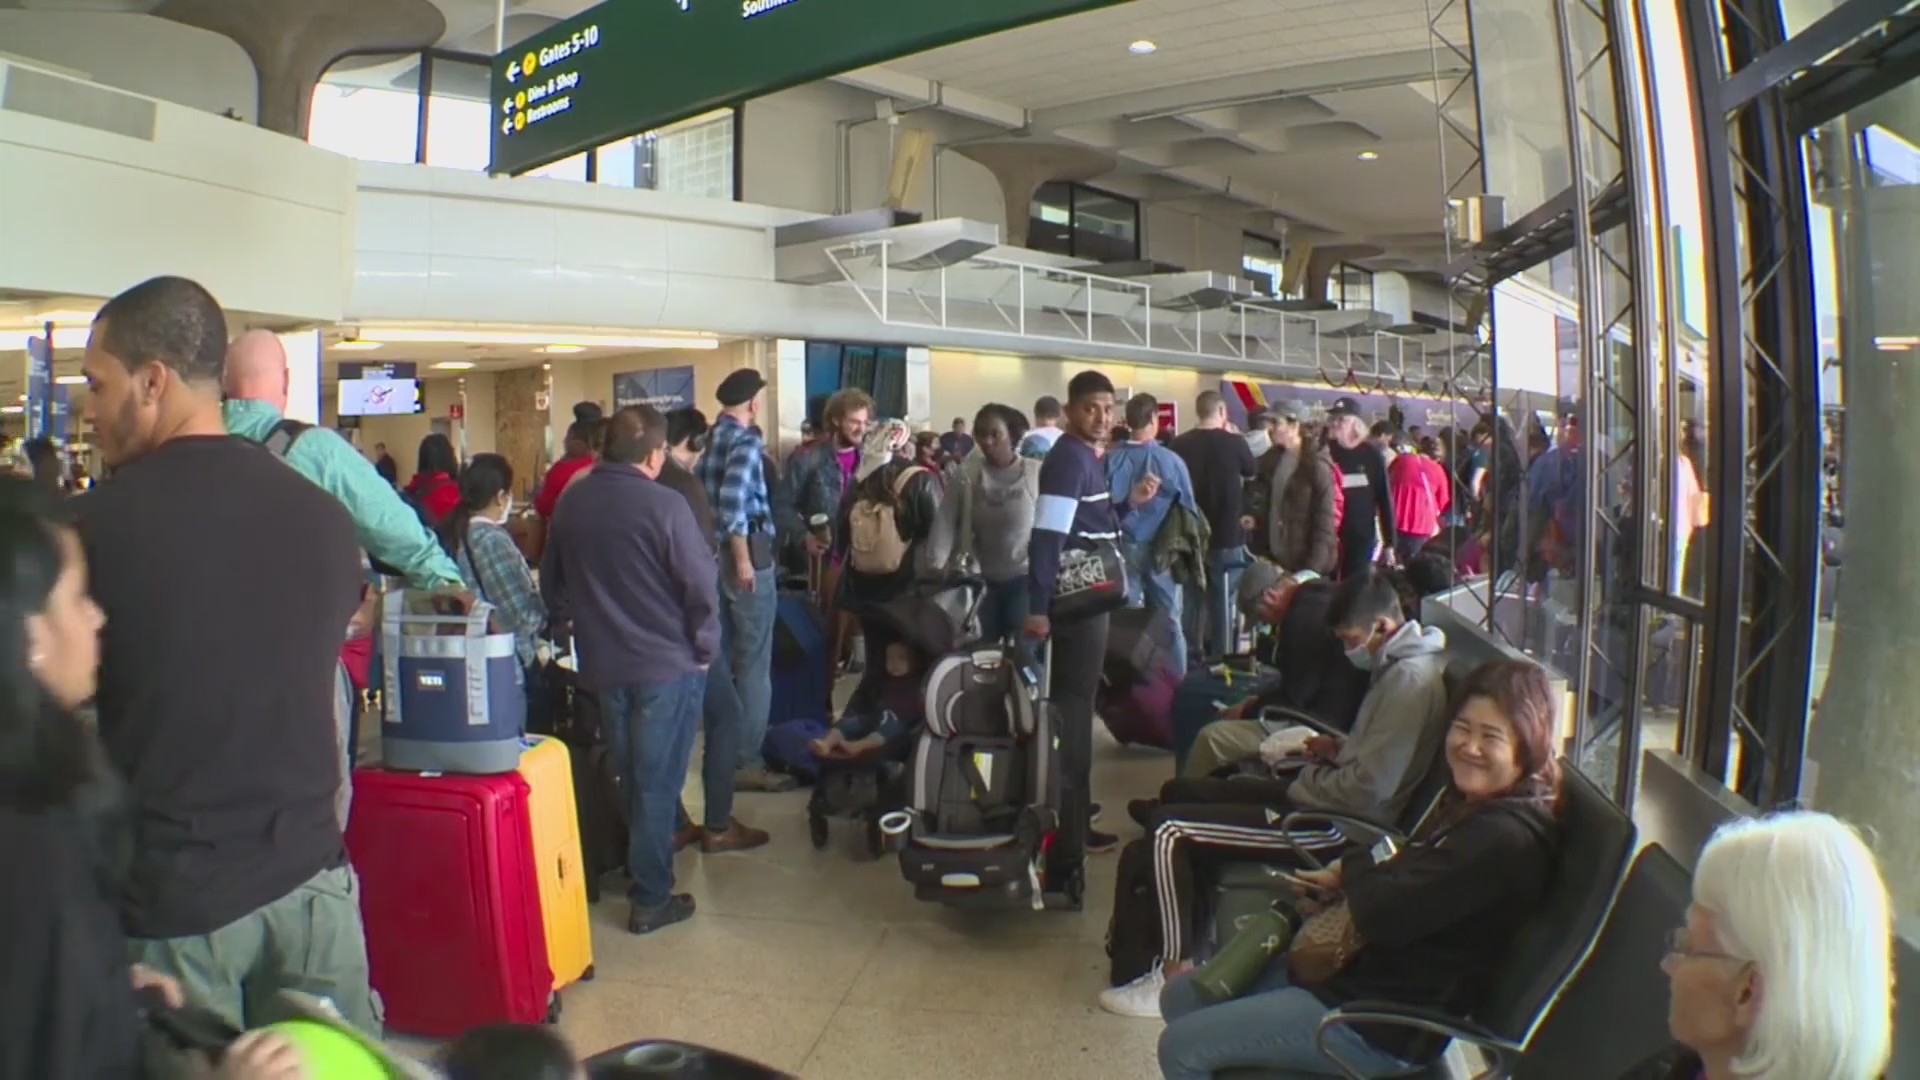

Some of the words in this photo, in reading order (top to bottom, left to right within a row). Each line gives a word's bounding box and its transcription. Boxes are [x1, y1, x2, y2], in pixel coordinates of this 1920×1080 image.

[539, 41, 571, 67] Gates
[571, 24, 599, 54] 5-10
[527, 85, 547, 103] Dine
[556, 71, 579, 91] Shop
[527, 96, 570, 123] Restrooms
[419, 675, 443, 685] YETI
